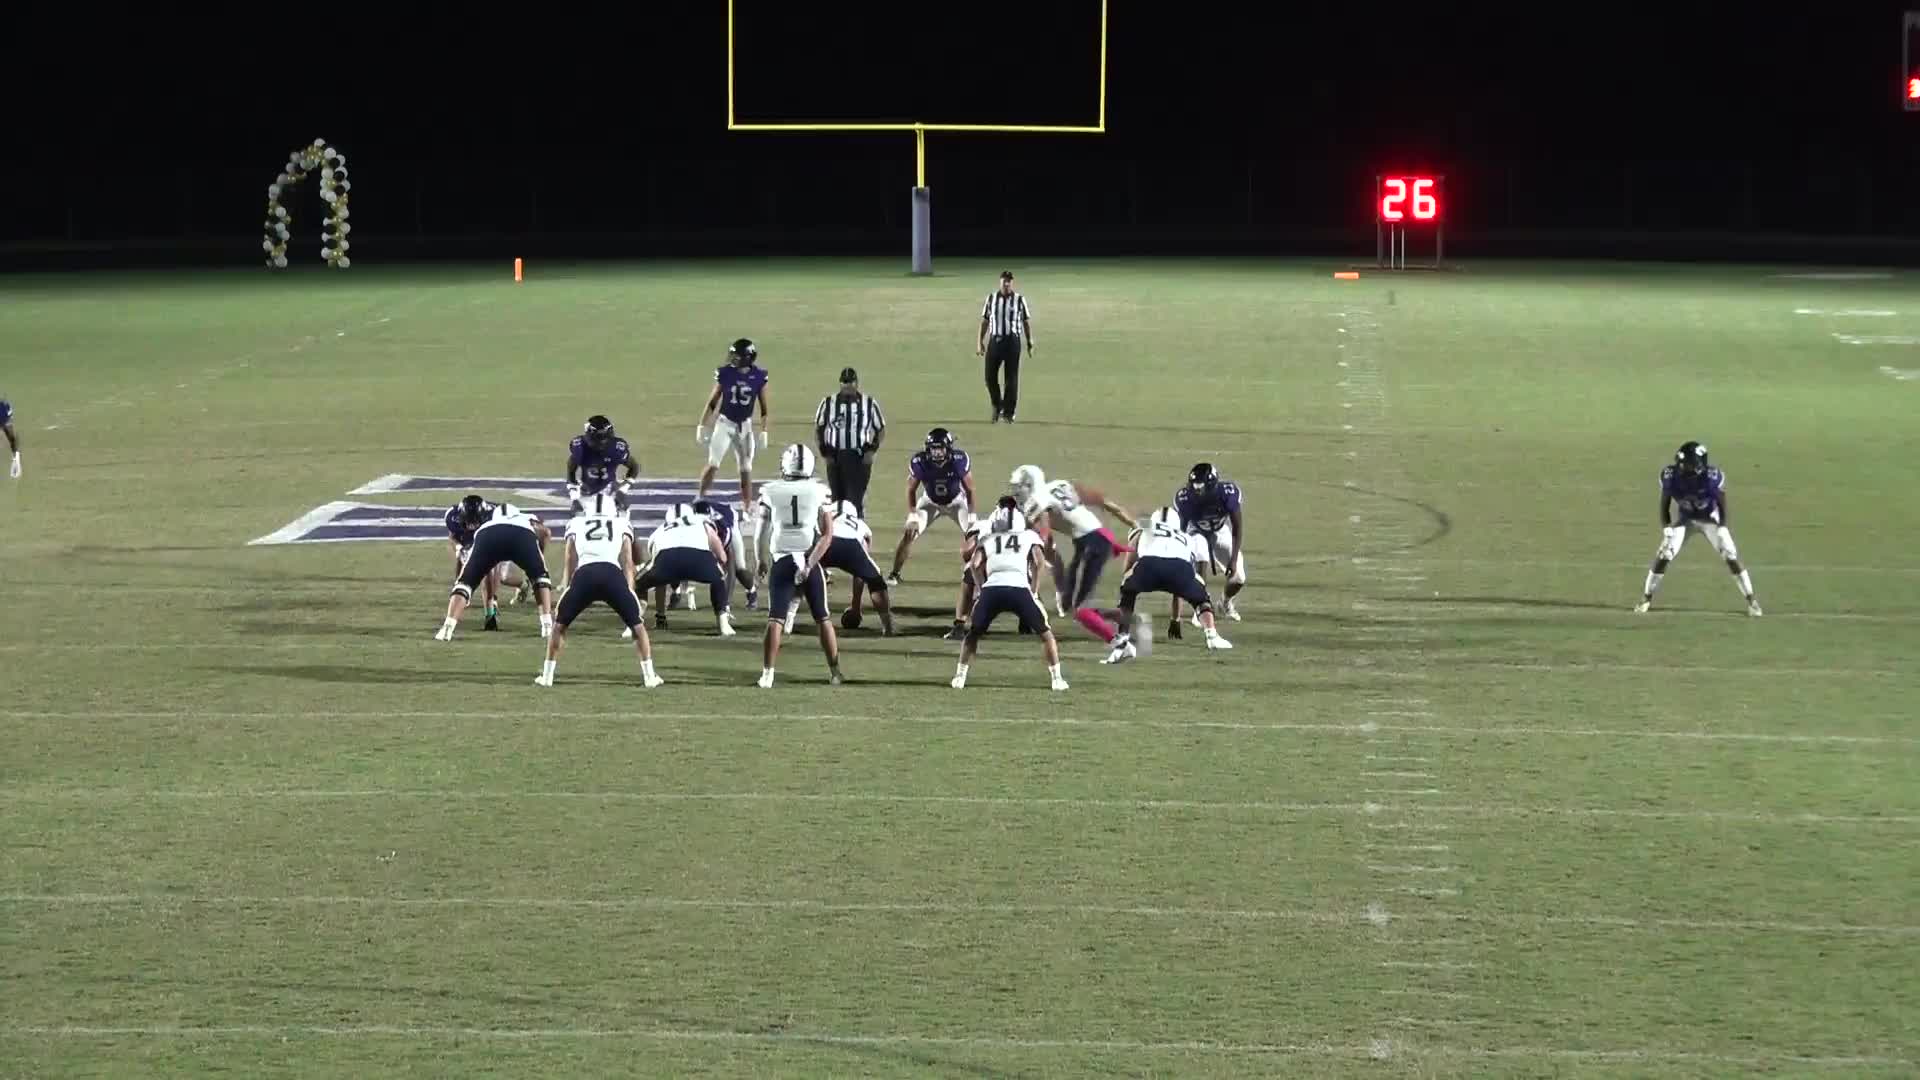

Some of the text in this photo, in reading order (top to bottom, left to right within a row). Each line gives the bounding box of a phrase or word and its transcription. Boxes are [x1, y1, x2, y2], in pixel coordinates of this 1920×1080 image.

[1384, 179, 1436, 219] 26
[730, 385, 752, 406] 15
[791, 495, 798, 526] 1
[585, 519, 613, 542] 21
[995, 534, 1021, 555] 14
